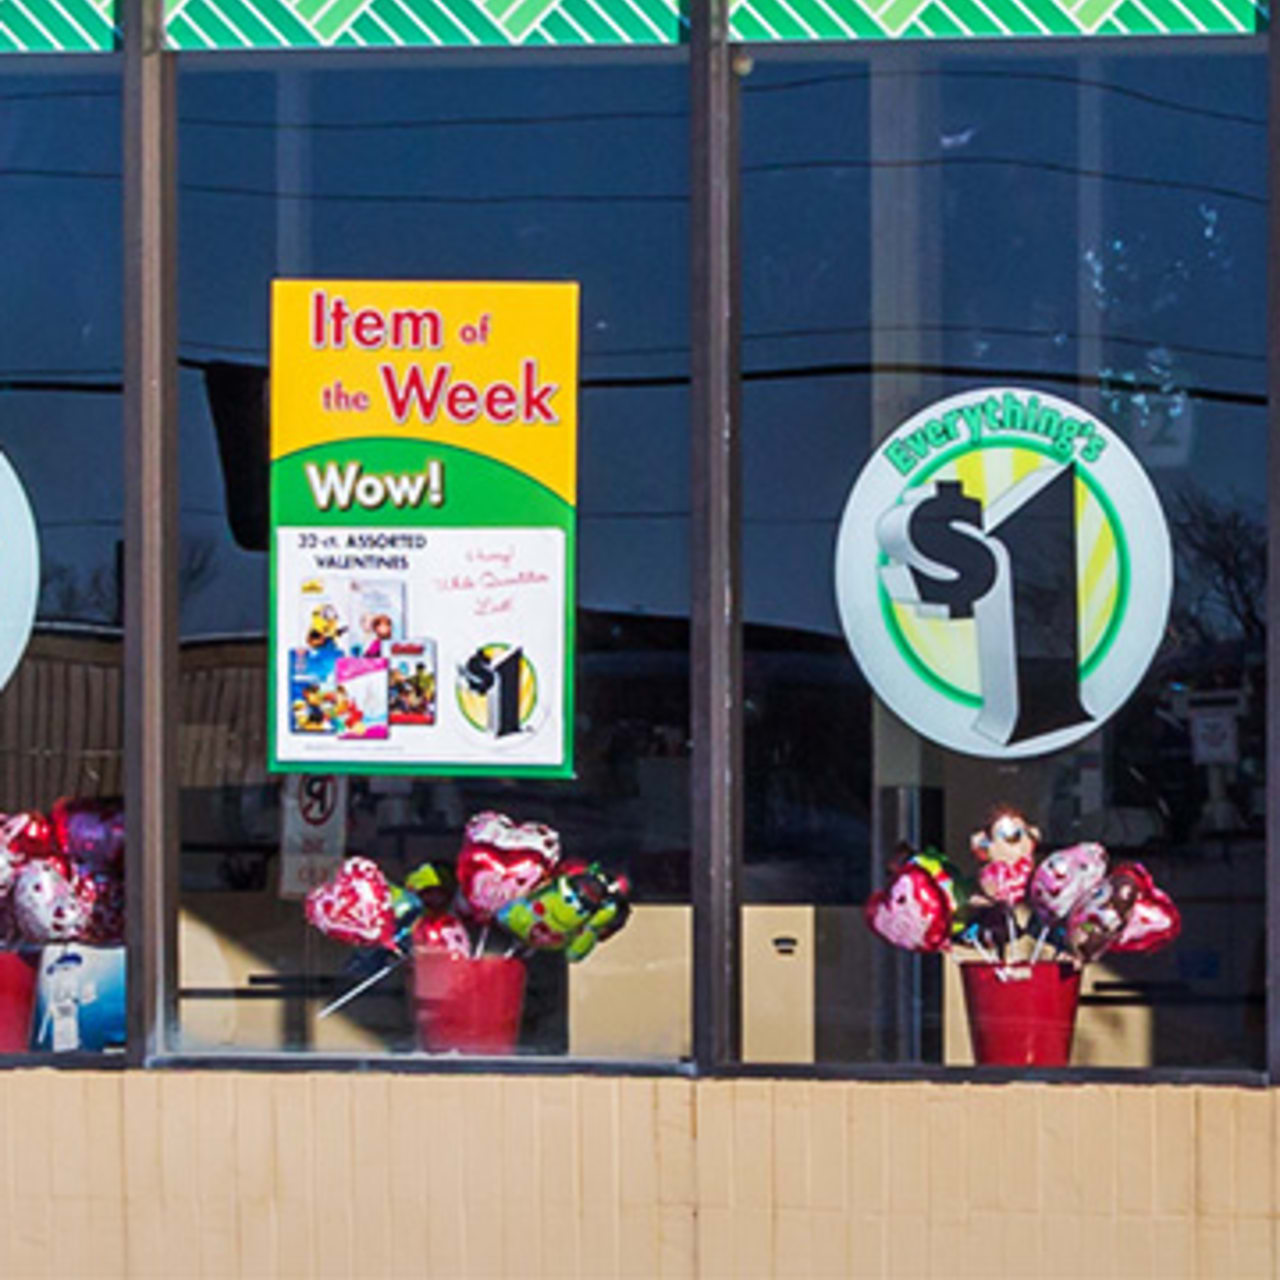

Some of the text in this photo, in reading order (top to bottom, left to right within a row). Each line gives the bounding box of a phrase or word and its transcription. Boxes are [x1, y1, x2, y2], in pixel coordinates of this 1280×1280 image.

[312, 290, 491, 348] Item of
[322, 358, 560, 423] the Week
[883, 392, 1108, 476] Everything's
[304, 460, 444, 510] Wow!
[313, 553, 410, 570] VALENTINES
[345, 531, 428, 550] ASSORTED
[906, 461, 1098, 747] $1
